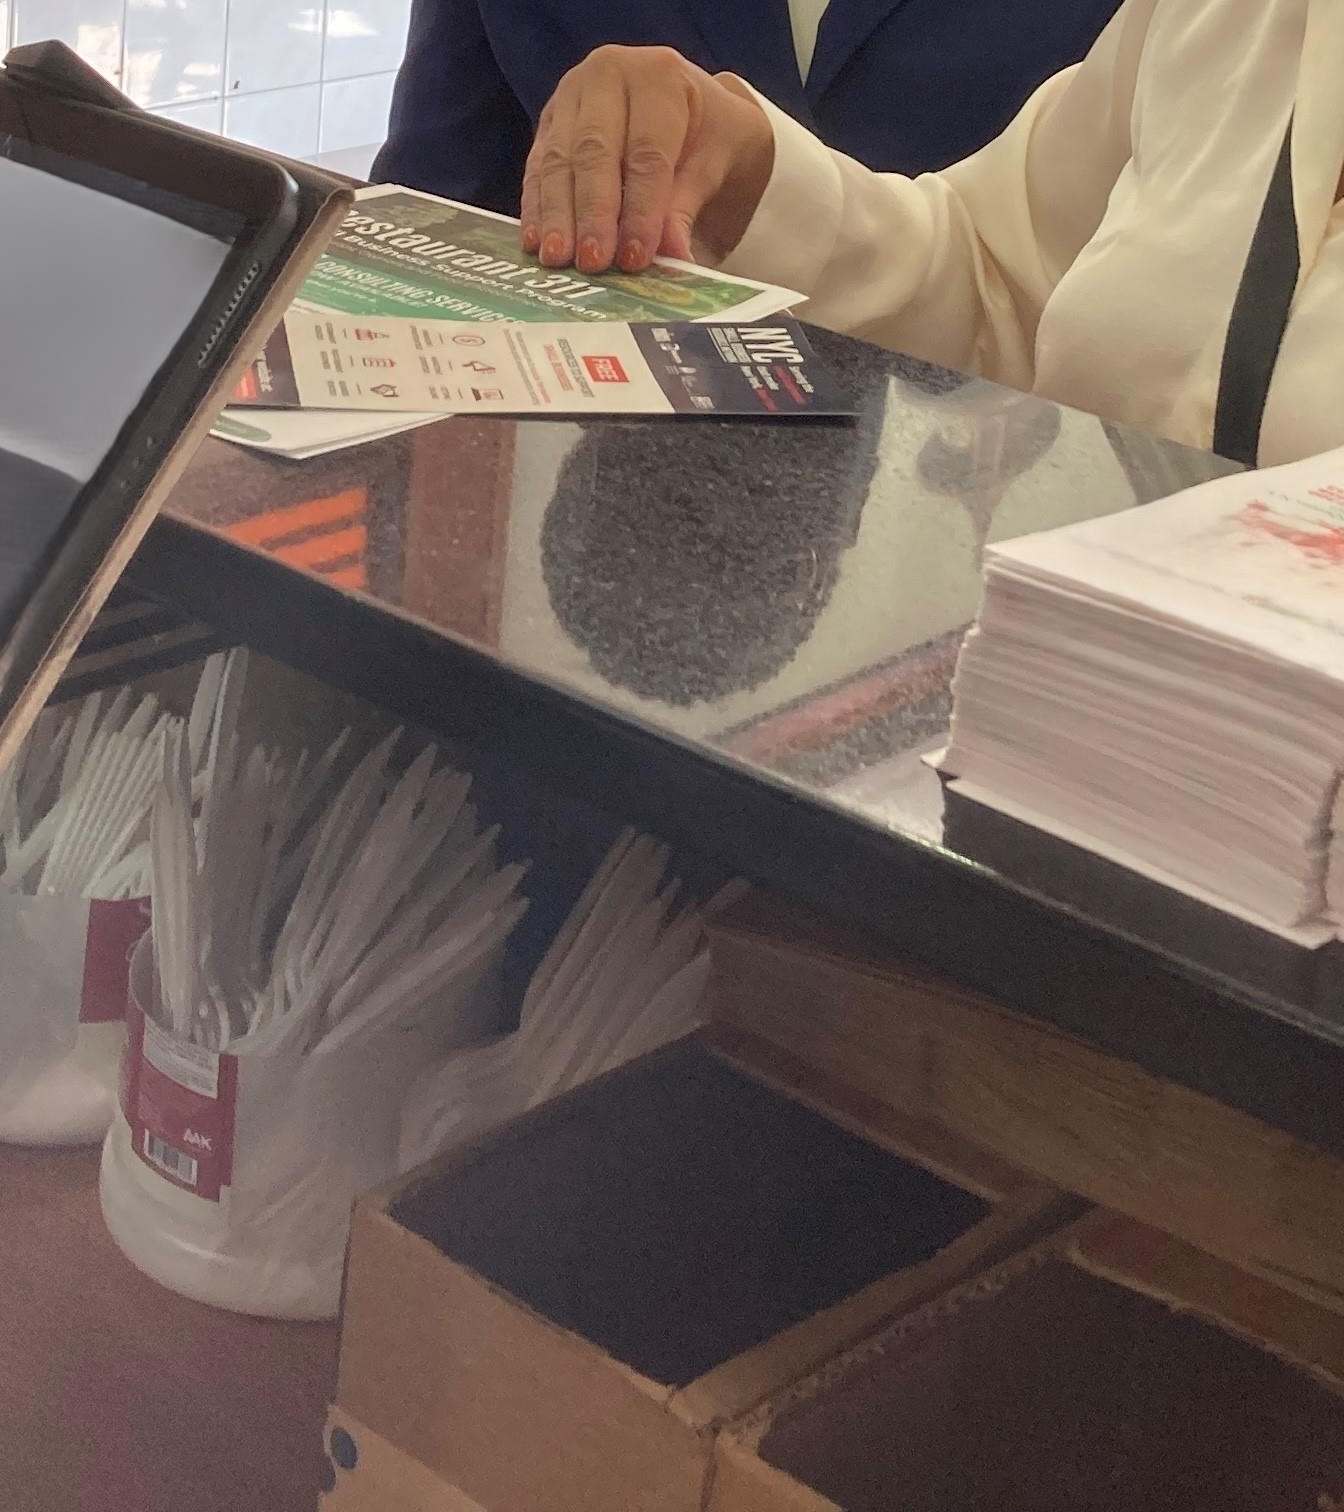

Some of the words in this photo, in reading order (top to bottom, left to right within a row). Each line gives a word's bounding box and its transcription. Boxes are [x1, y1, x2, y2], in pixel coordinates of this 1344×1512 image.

[341, 210, 539, 280] estaurant
[527, 274, 608, 300] 311
[315, 261, 434, 299] CONSULTING
[343, 235, 431, 266] Business
[433, 263, 513, 290] Support
[515, 288, 607, 320] Program
[737, 327, 805, 364] NYC
[591, 358, 619, 382] FREE
